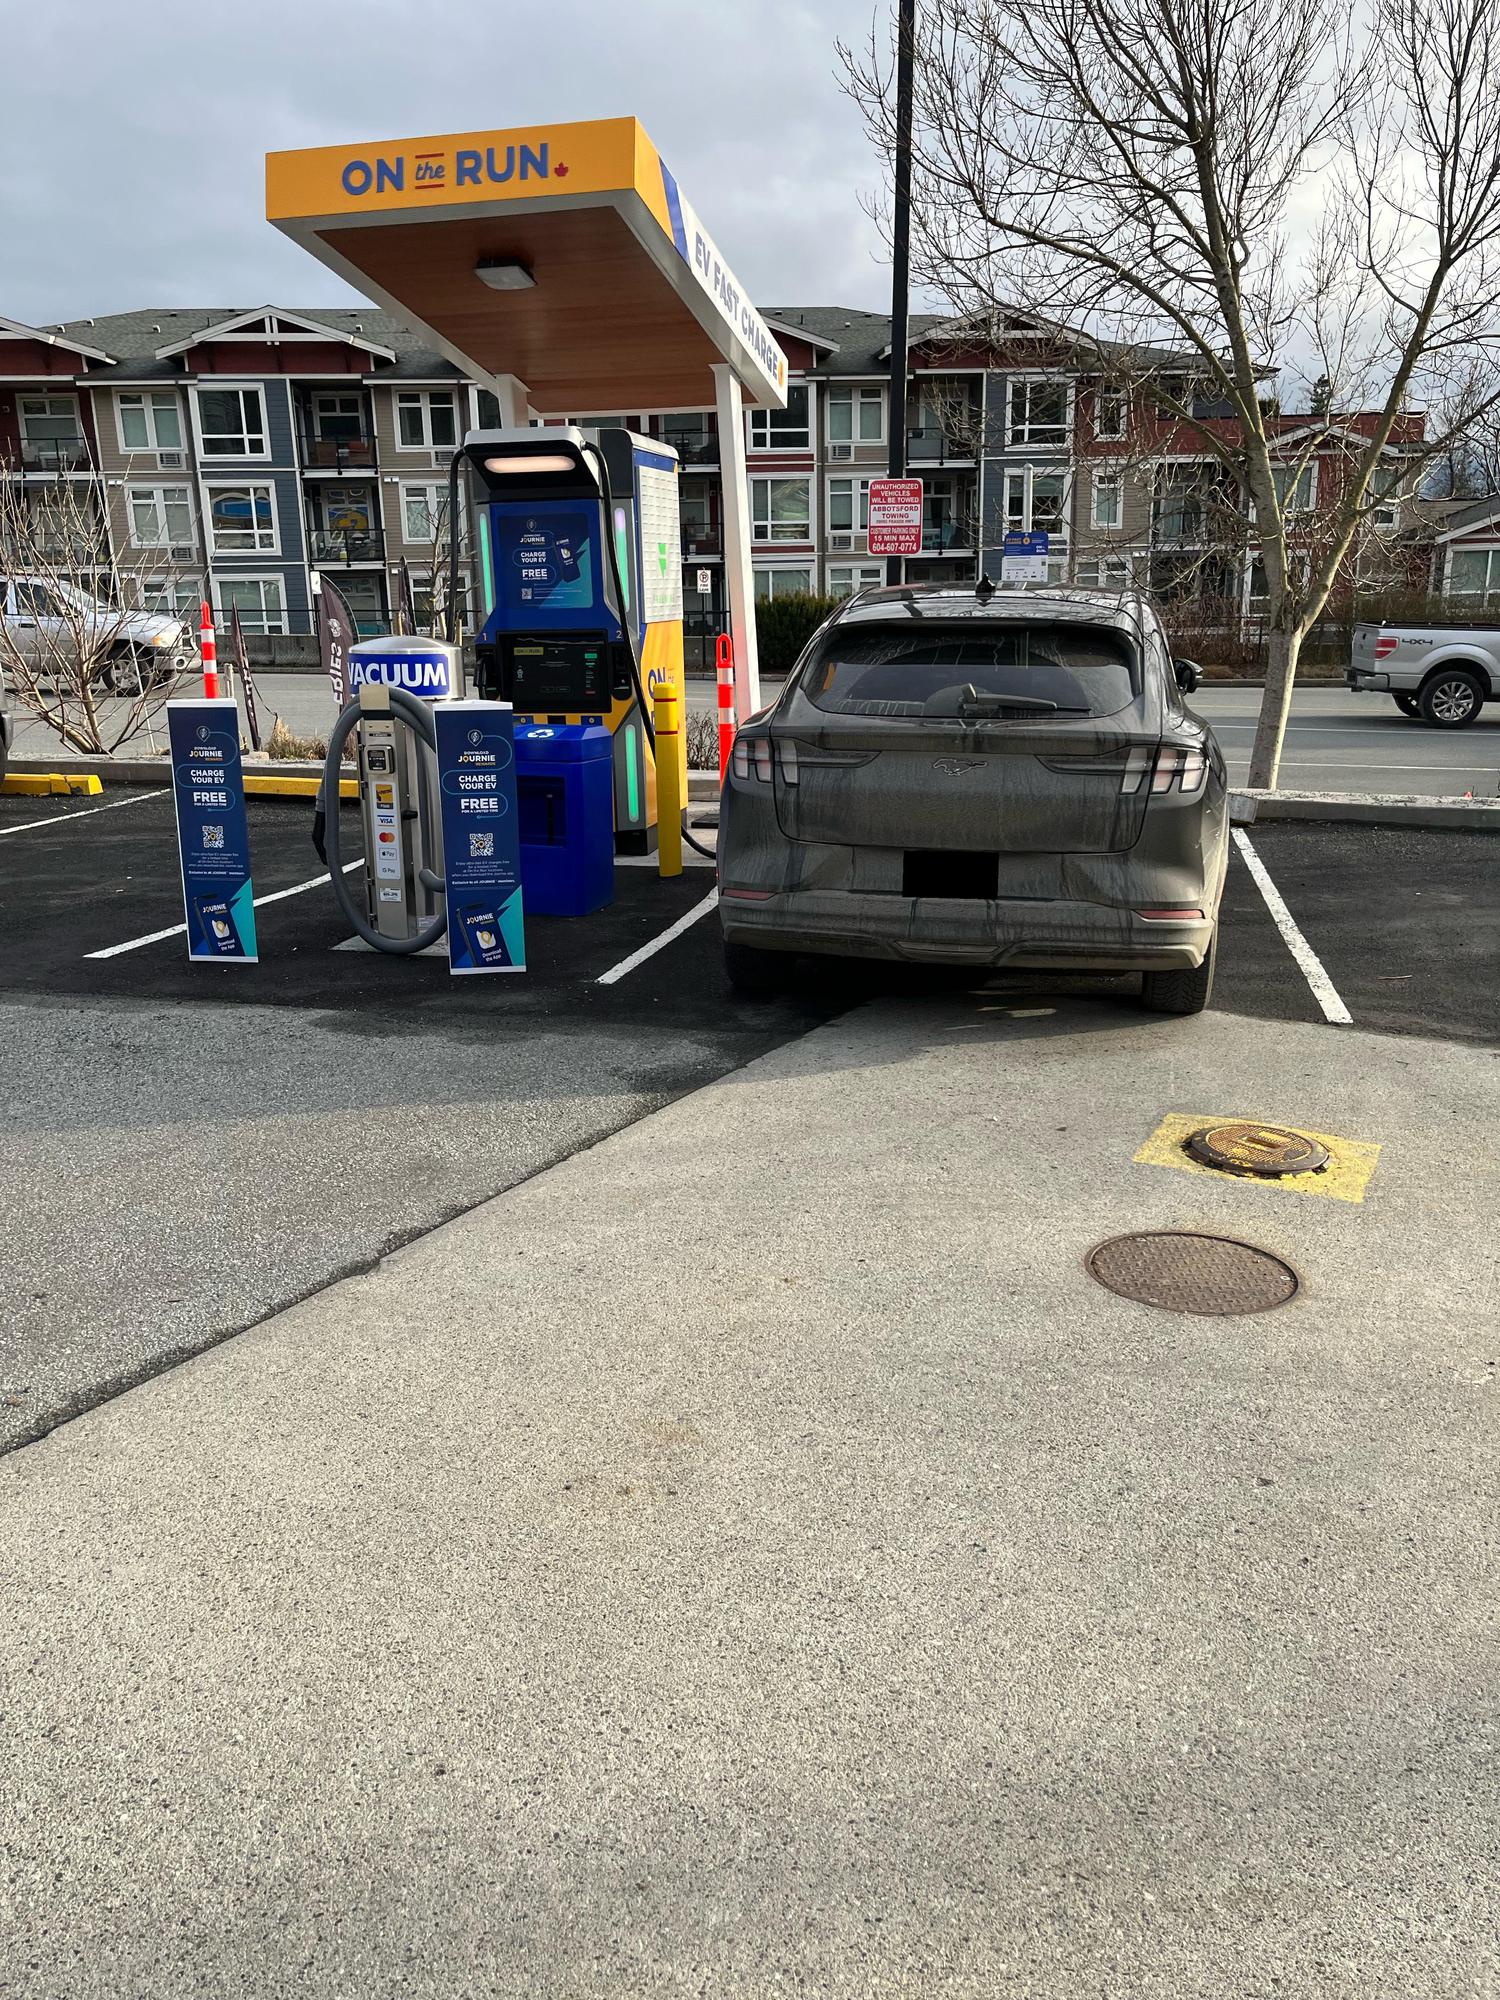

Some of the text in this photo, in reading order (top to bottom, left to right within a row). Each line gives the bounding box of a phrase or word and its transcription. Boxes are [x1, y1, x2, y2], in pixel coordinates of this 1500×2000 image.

[342, 143, 549, 196] ON the RUN
[696, 231, 778, 380] EV FAST CHARGE
[872, 542, 917, 551] 604-607-0774
[522, 569, 547, 577] FREE
[616, 630, 622, 639] 2
[347, 662, 447, 687] VACUUM
[458, 755, 496, 763] JOURNIE
[193, 792, 227, 803] FREE
[461, 798, 498, 809] FREE
[466, 913, 494, 924] JOURNIE
[482, 948, 502, 958] Download
